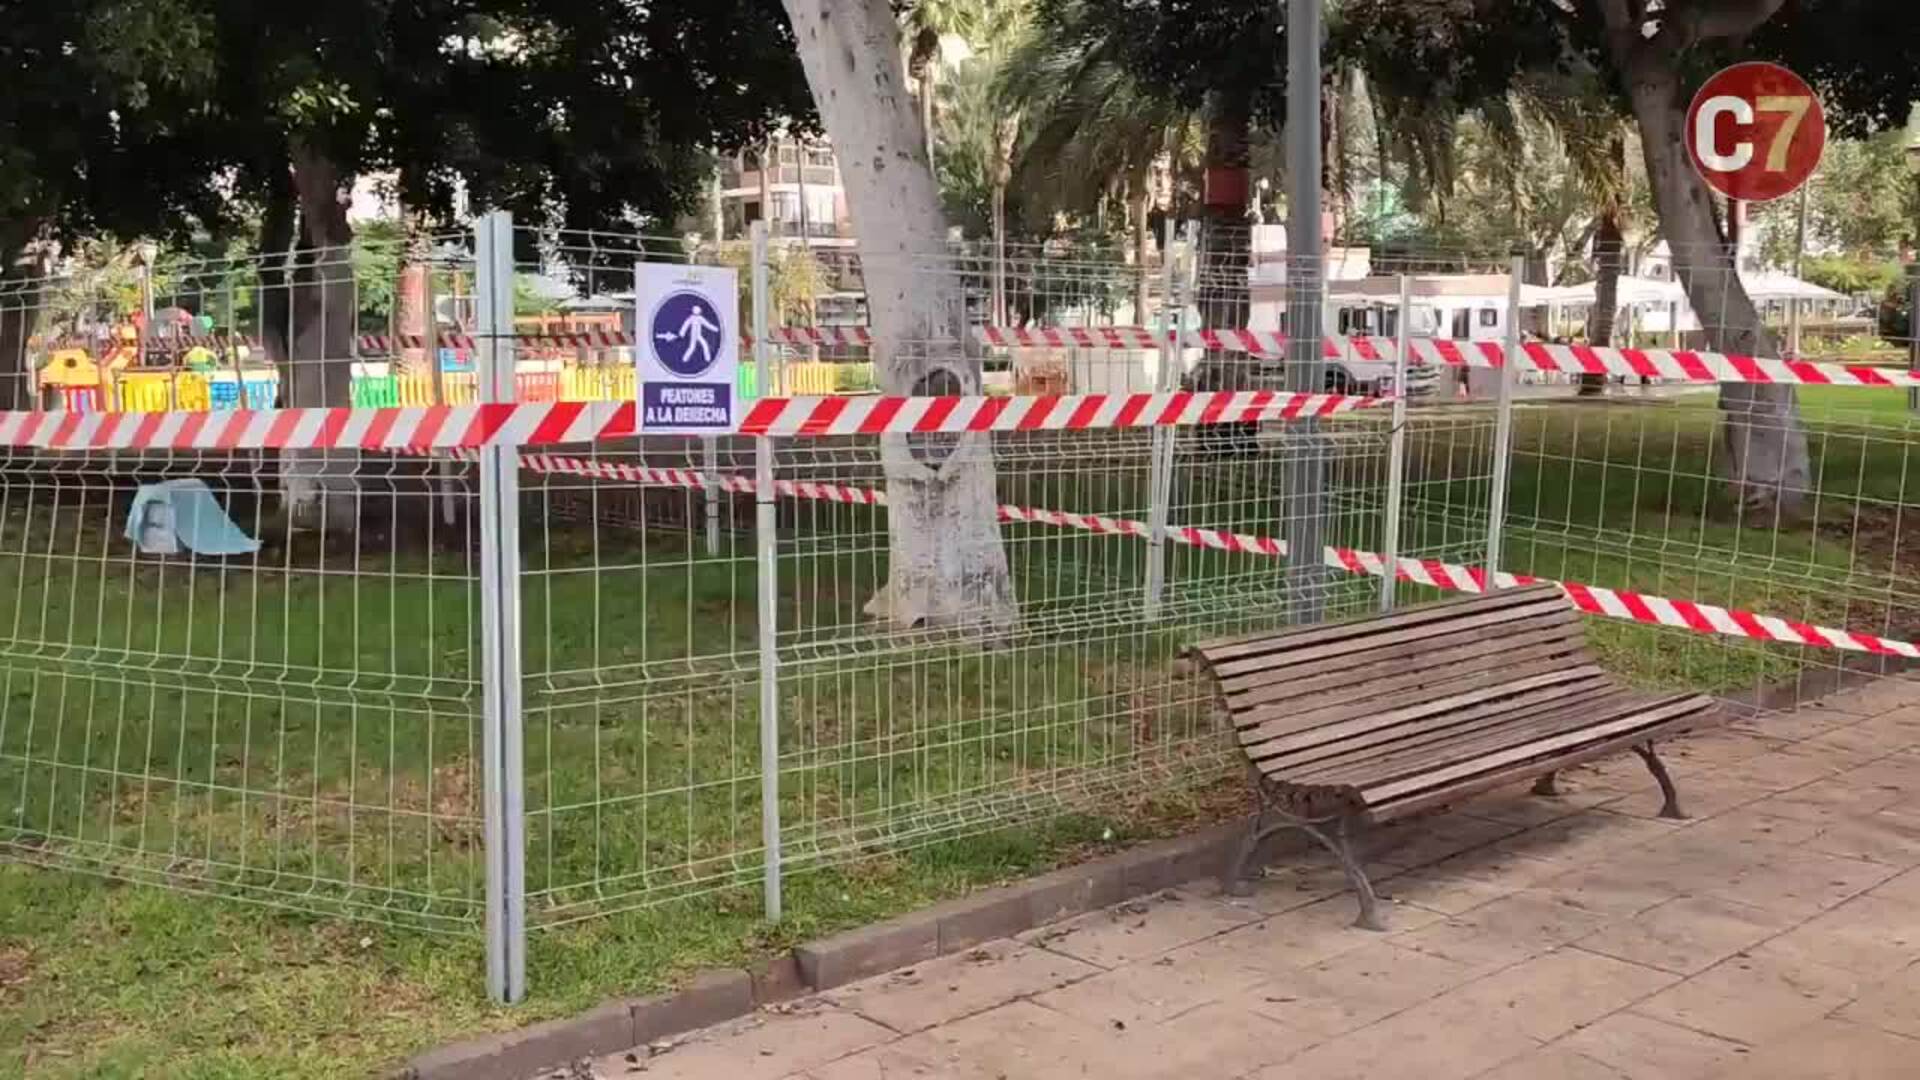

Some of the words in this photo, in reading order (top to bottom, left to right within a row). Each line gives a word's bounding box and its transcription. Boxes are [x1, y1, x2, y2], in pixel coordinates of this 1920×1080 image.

[660, 388, 715, 404] PEATONES
[646, 407, 656, 423] A
[657, 407, 673, 423] LA
[674, 406, 728, 423] DERECHA
